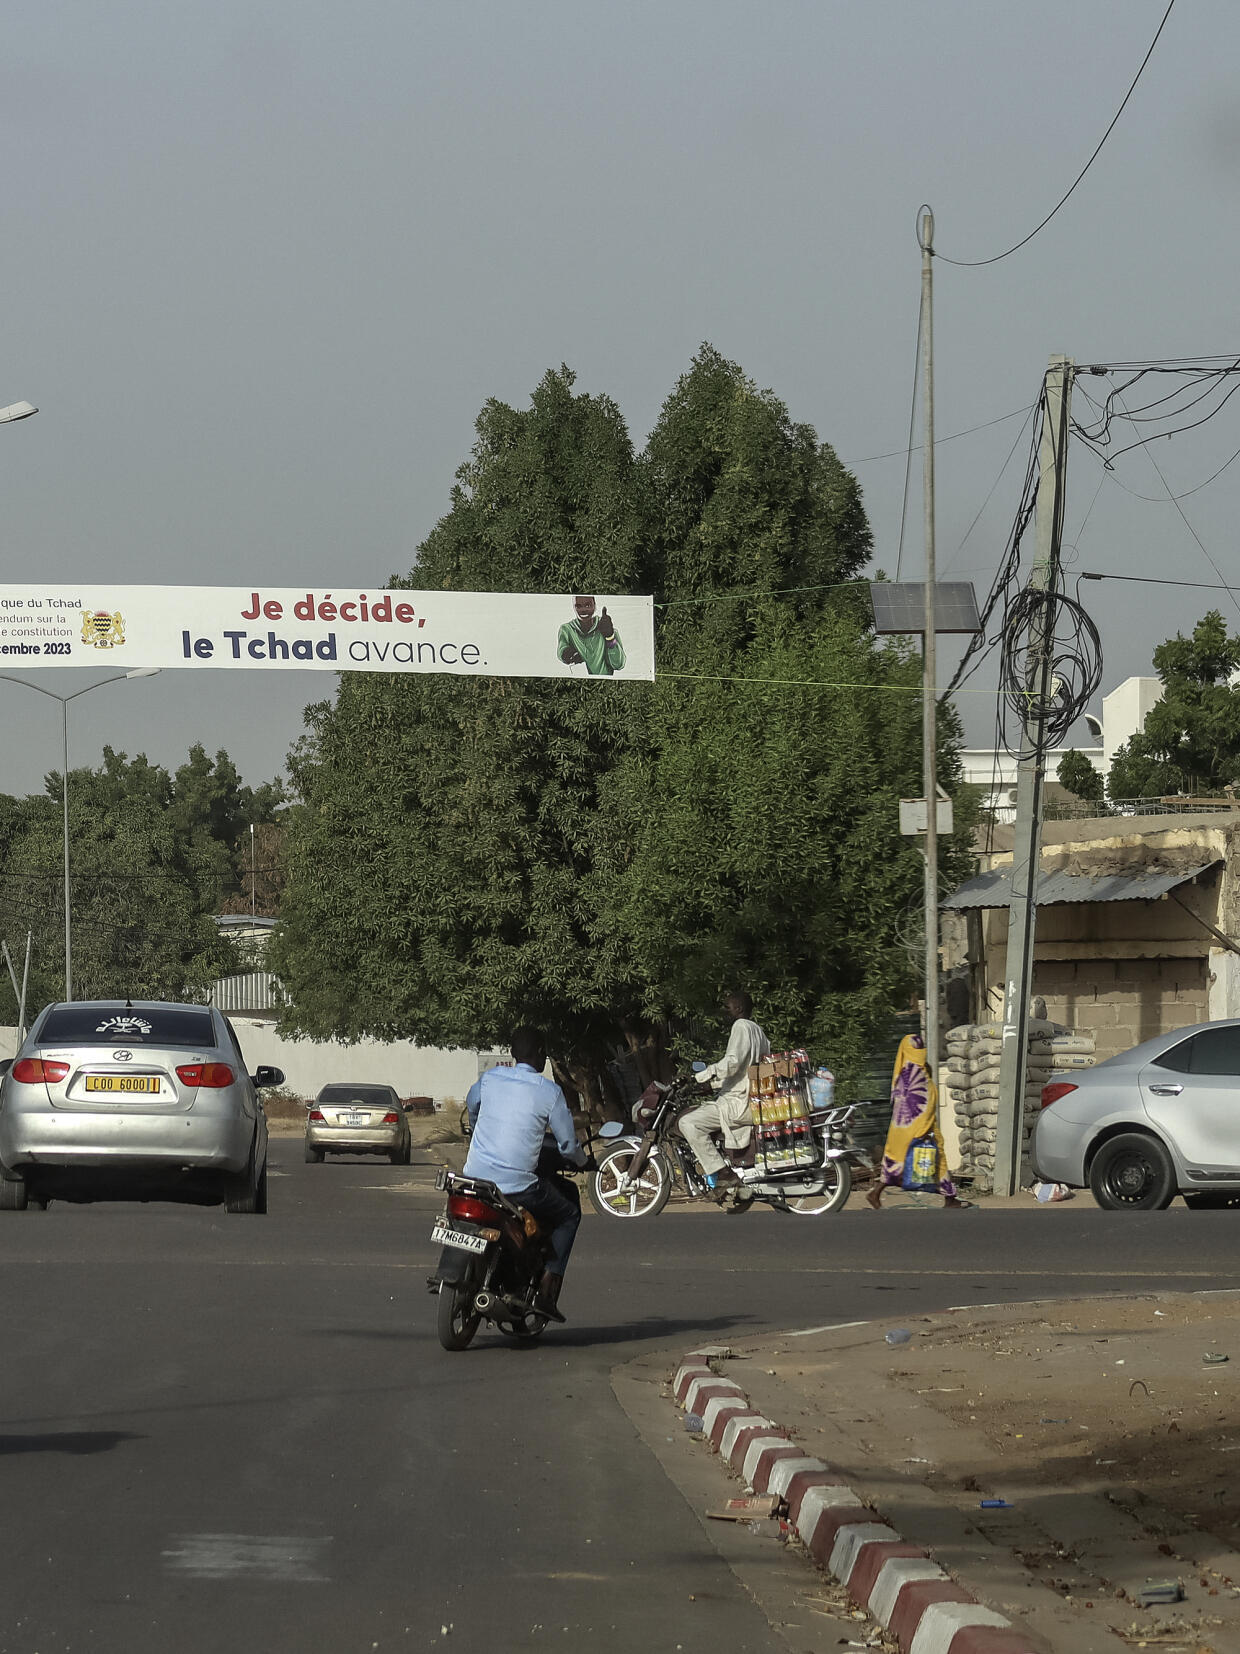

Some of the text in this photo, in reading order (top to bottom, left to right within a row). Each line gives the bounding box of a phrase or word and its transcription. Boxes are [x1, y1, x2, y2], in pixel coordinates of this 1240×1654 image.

[27, 598, 43, 608] du
[45, 598, 82, 609] Tchad
[240, 592, 427, 628] Je décide,
[36, 616, 53, 624] sur
[57, 614, 66, 624] la
[11, 627, 73, 637] constitution
[43, 642, 72, 655] 2023
[181, 630, 488, 666] le Tchad avance.
